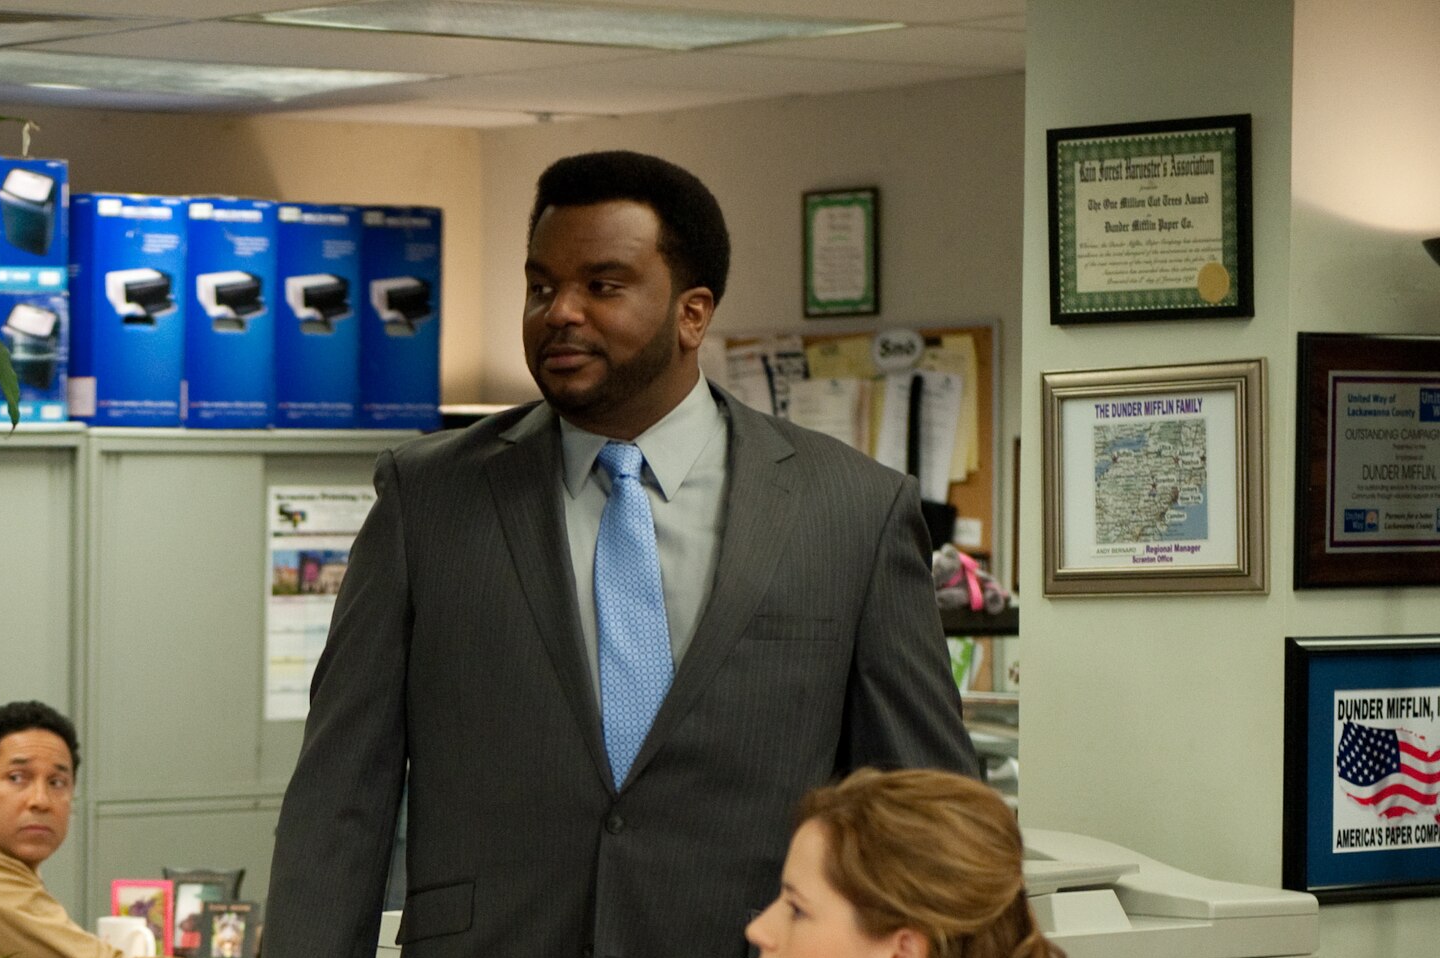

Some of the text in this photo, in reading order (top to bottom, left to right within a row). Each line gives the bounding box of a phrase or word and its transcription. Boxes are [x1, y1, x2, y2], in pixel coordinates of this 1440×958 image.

[1098, 159, 1123, 182] Forest
[1169, 151, 1215, 178] Association
[1087, 198, 1101, 213] The
[1102, 198, 1119, 210] One
[1119, 196, 1146, 210] Million
[1184, 192, 1209, 206] Award
[1104, 220, 1130, 233] Dunder
[1131, 218, 1157, 232] Mifflin
[1158, 217, 1179, 233] Paper
[1347, 393, 1397, 405] United Way of
[1094, 396, 1203, 419] THE DUNDER MIFFLIN FAMILY
[1391, 407, 1416, 419] County
[1345, 428, 1399, 441] OUTSTANDING
[1362, 464, 1400, 481] DUNDER
[1096, 546, 1137, 555] ANDY BERNARD
[1145, 542, 1202, 556] Regional Manager
[1131, 554, 1174, 565] Scranton Office
[1337, 697, 1384, 721] DUNDER
[1386, 695, 1435, 723] MIFFLIN,
[1336, 827, 1384, 849] AMERICA'S
[1385, 825, 1413, 846] PAPER
